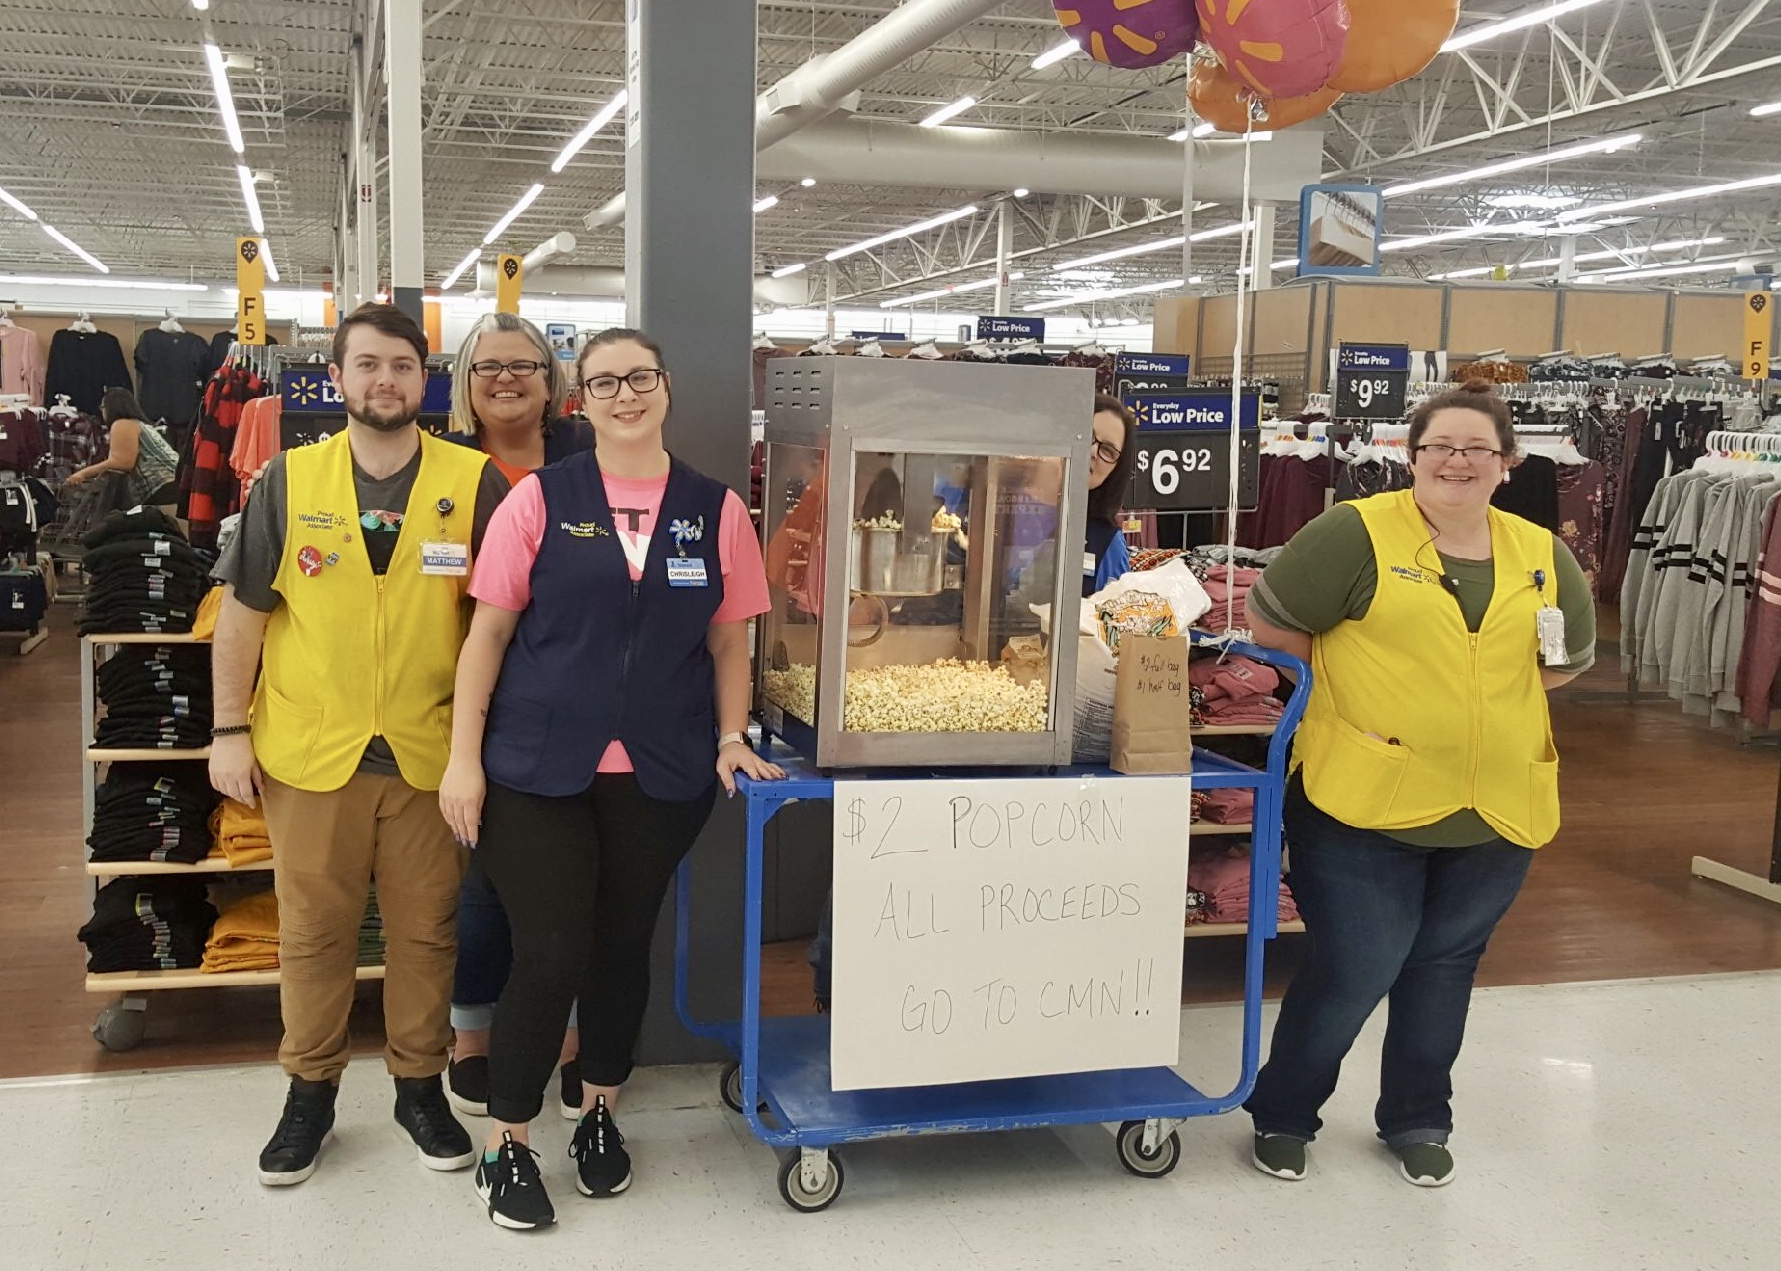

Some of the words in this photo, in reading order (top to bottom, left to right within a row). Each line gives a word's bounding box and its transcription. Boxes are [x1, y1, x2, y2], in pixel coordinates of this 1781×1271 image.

[244, 297, 256, 316] F
[245, 323, 255, 340] 5
[992, 323, 1009, 332] Low
[1010, 323, 1031, 333] Price
[1751, 341, 1762, 356] F
[1131, 362, 1149, 371] Low
[1149, 363, 1171, 372] Price
[1354, 355, 1370, 365] Low
[1371, 355, 1390, 366] Price
[1751, 362, 1761, 375] 9
[322, 388, 345, 403] Lo
[1152, 402, 1180, 410] Everyday
[1152, 409, 1184, 424] Low
[1186, 408, 1225, 423] Price
[298, 513, 333, 525] Walmart
[561, 522, 595, 533] Walmart
[427, 557, 462, 565] MATTHEW
[1390, 566, 1422, 579] Walmart
[843, 796, 928, 859] $2
[949, 796, 1124, 849] POPCORN
[874, 882, 949, 940] ALL
[981, 883, 1141, 932] PROCEEDS
[901, 984, 953, 1035] GO
[972, 978, 1017, 1031] TO
